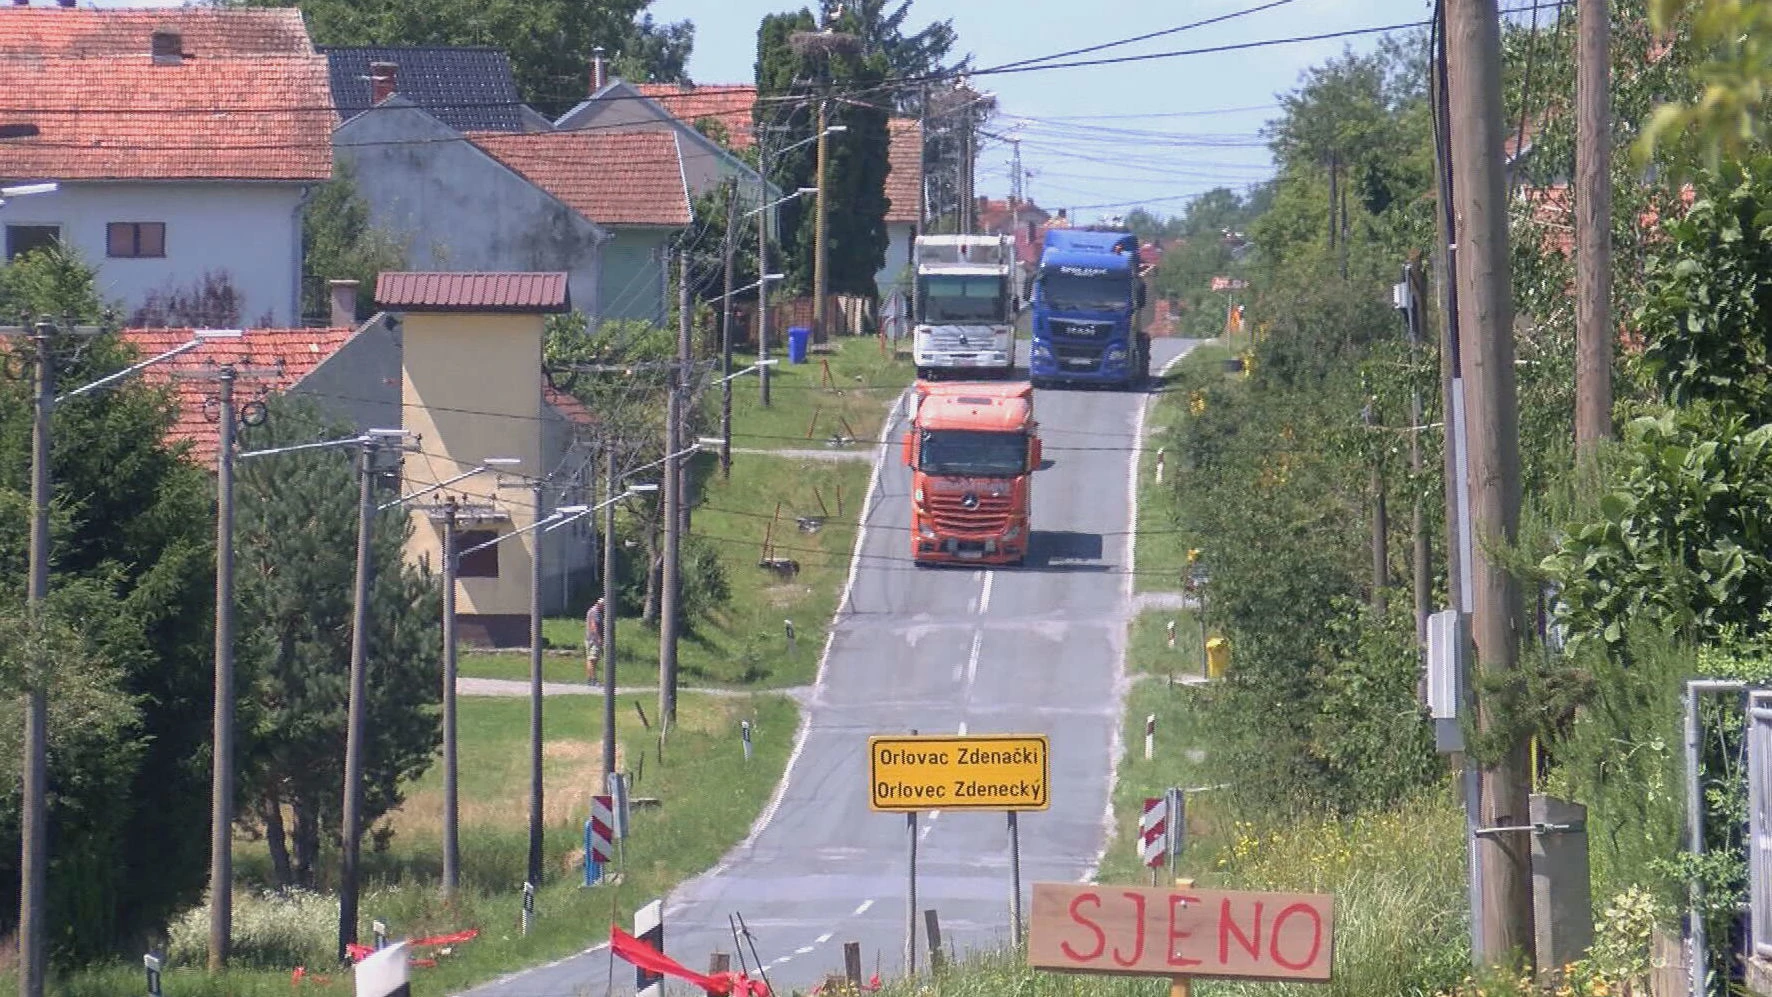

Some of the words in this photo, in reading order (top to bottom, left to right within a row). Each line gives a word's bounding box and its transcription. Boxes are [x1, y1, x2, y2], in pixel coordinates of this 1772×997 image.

[880, 748, 949, 765] Orlovac
[957, 747, 1038, 765] Zdenački
[878, 780, 946, 798] Orlovec
[954, 779, 1041, 800] Zdenecký
[1061, 892, 1322, 971] SJENO
